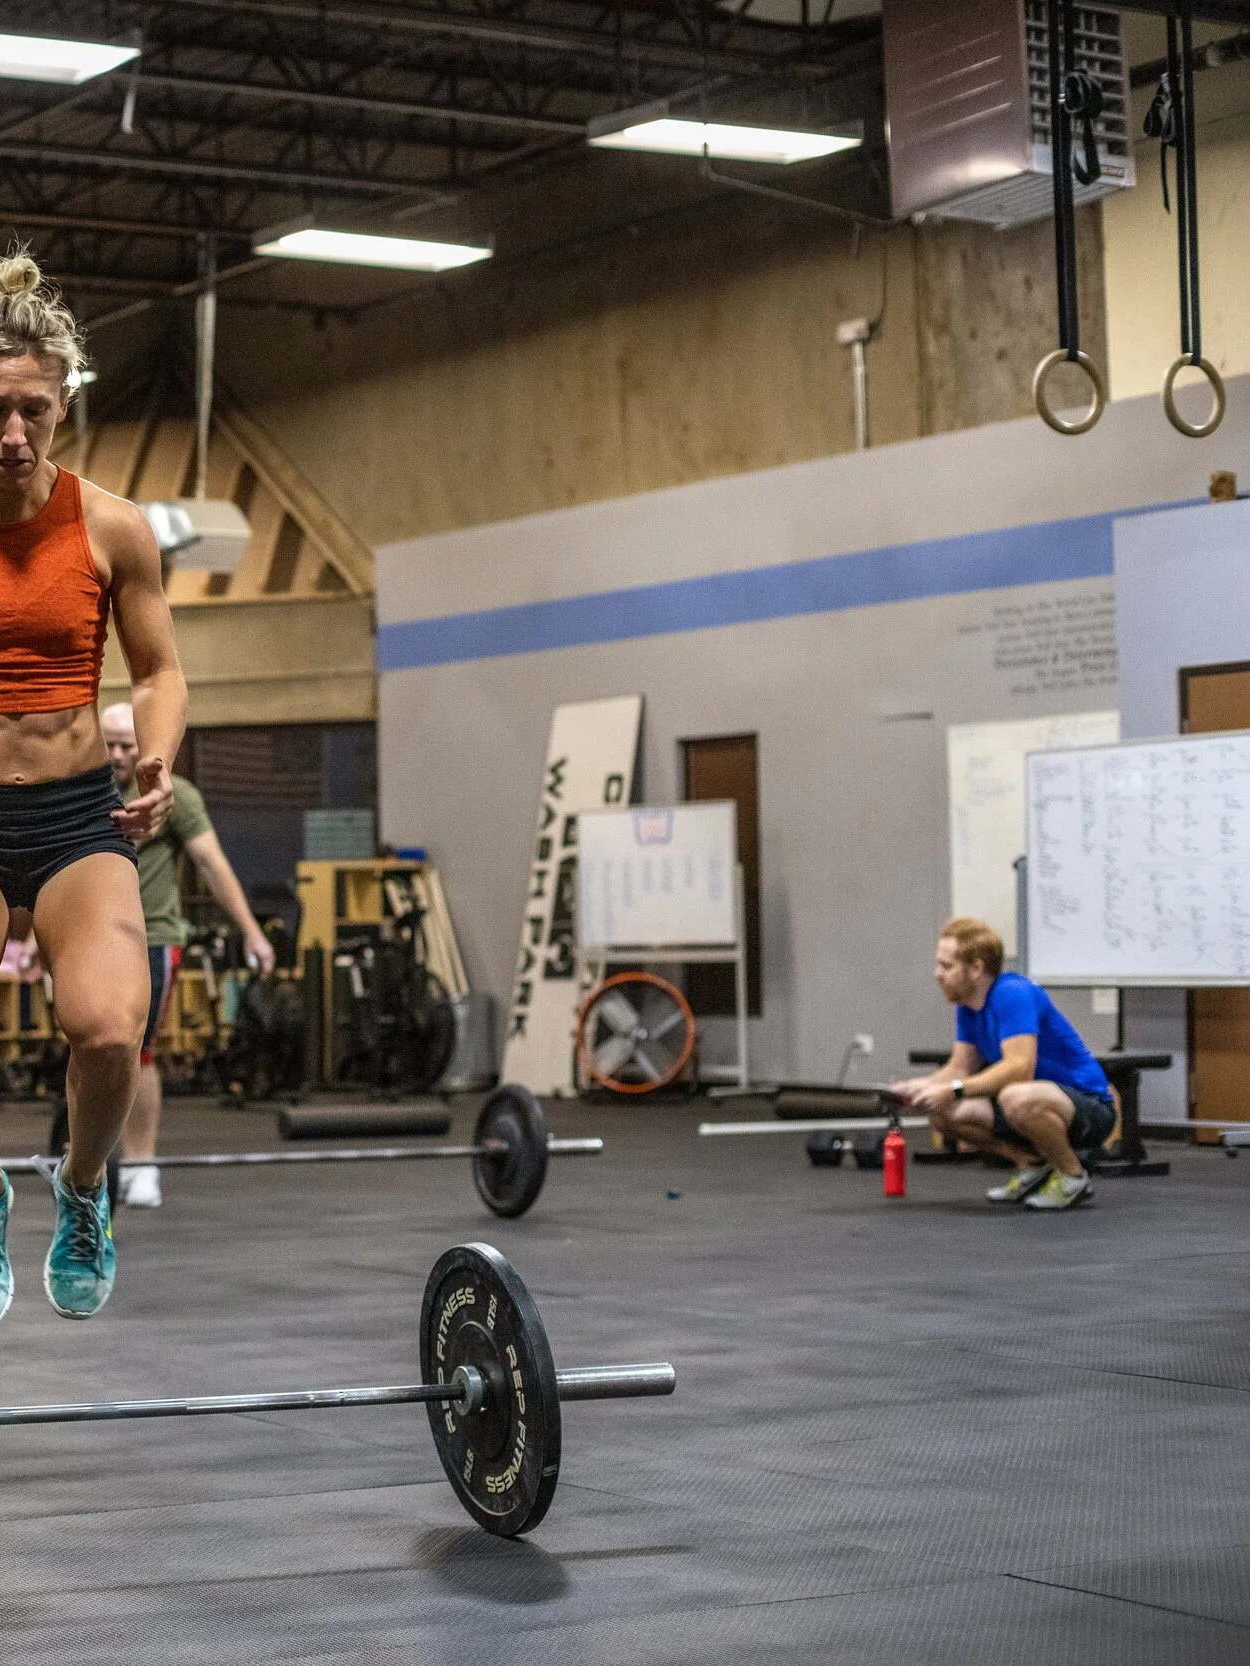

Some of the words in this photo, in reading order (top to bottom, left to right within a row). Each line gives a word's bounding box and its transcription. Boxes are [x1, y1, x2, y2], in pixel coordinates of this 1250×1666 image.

[436, 1287, 476, 1362] FITNESS
[505, 1344, 526, 1415] REP
[485, 1420, 527, 1494] FITNESS
